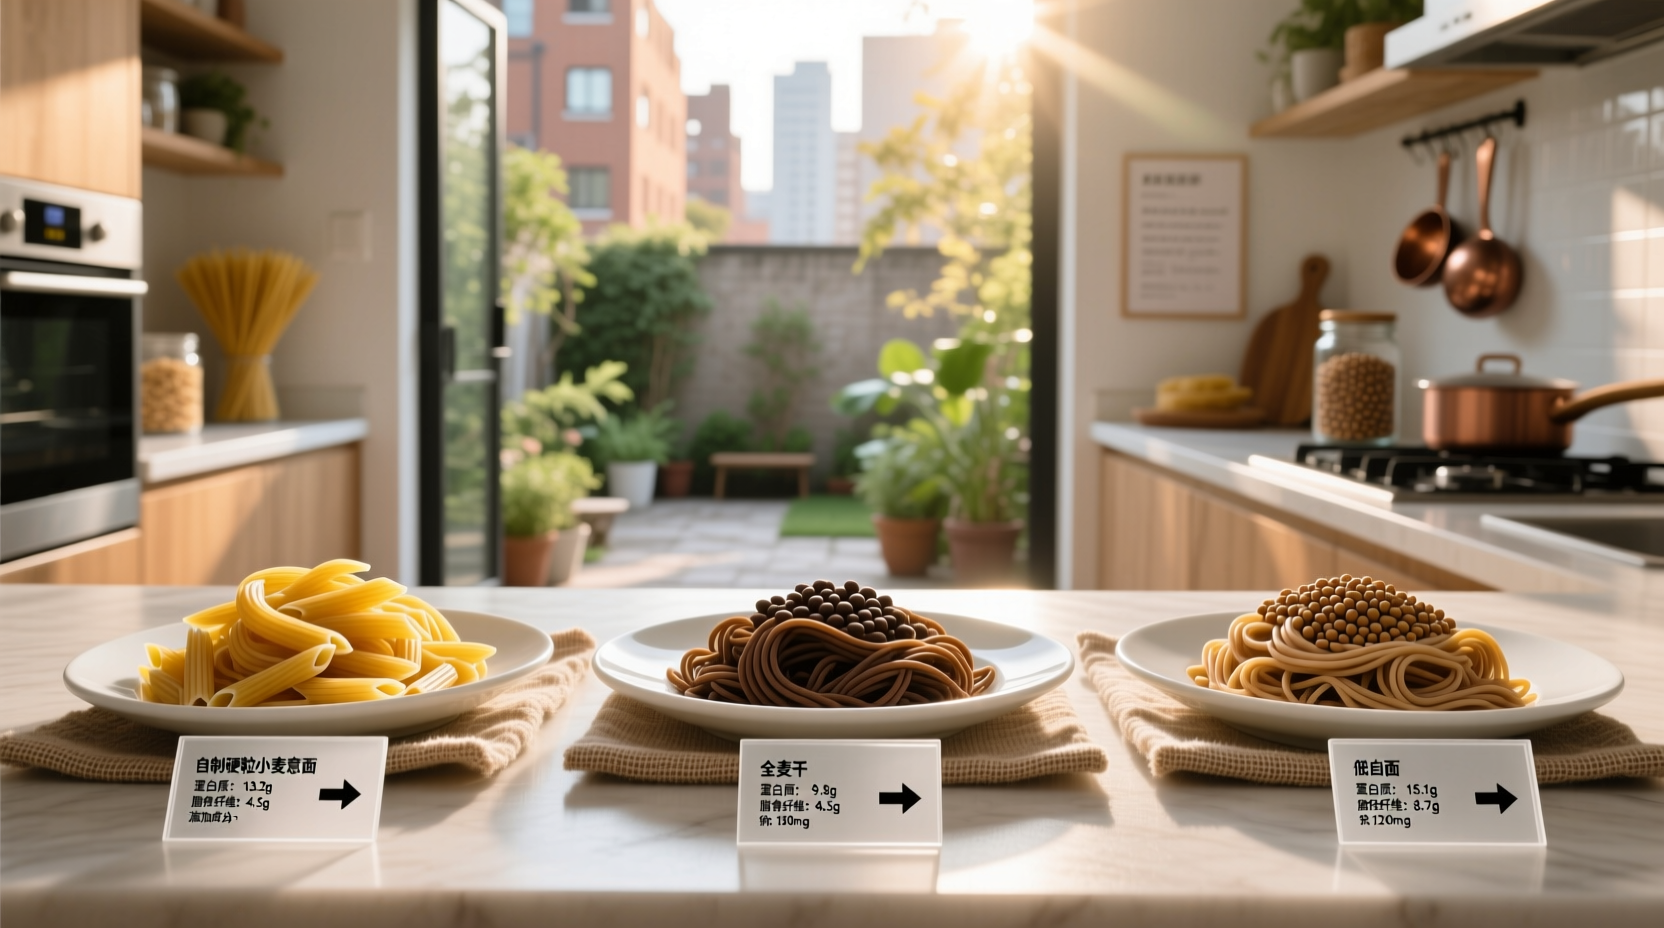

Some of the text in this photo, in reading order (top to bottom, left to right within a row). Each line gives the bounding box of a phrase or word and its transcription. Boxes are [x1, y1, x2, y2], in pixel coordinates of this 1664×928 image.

[1407, 783, 1438, 798] 15.1g
[815, 800, 840, 815] 4.5g
[1413, 799, 1440, 815] 8.7g
